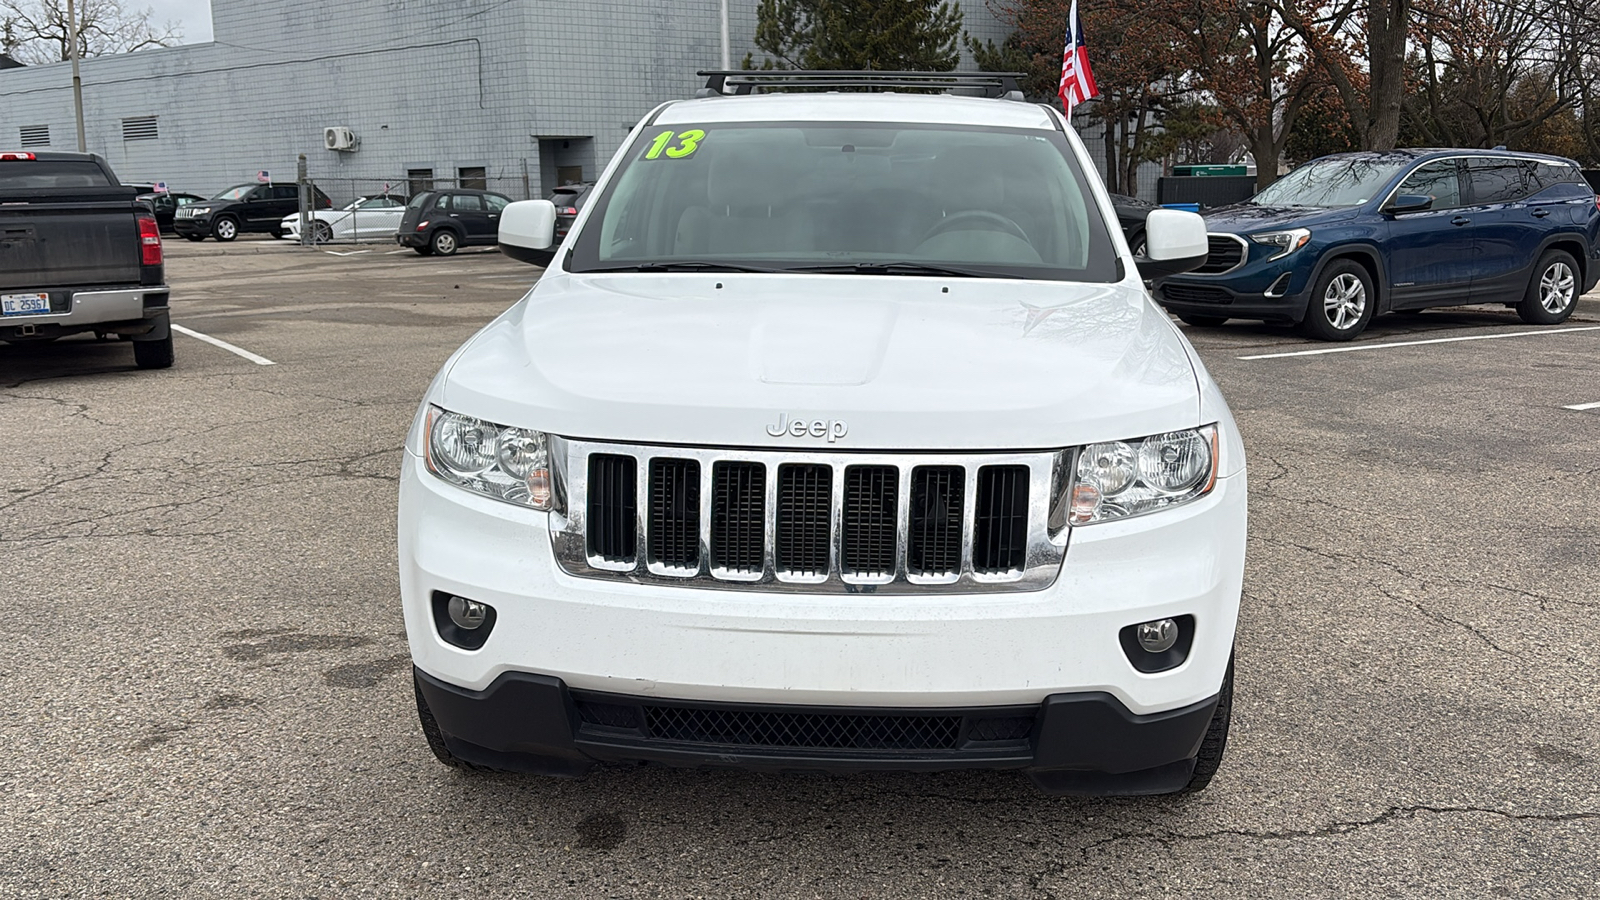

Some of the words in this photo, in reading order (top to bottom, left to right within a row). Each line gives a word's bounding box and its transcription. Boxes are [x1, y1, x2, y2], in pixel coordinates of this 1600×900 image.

[645, 129, 706, 160] 13
[4, 301, 15, 311] DC
[20, 299, 46, 310] 25967
[766, 413, 848, 443] Jeep
